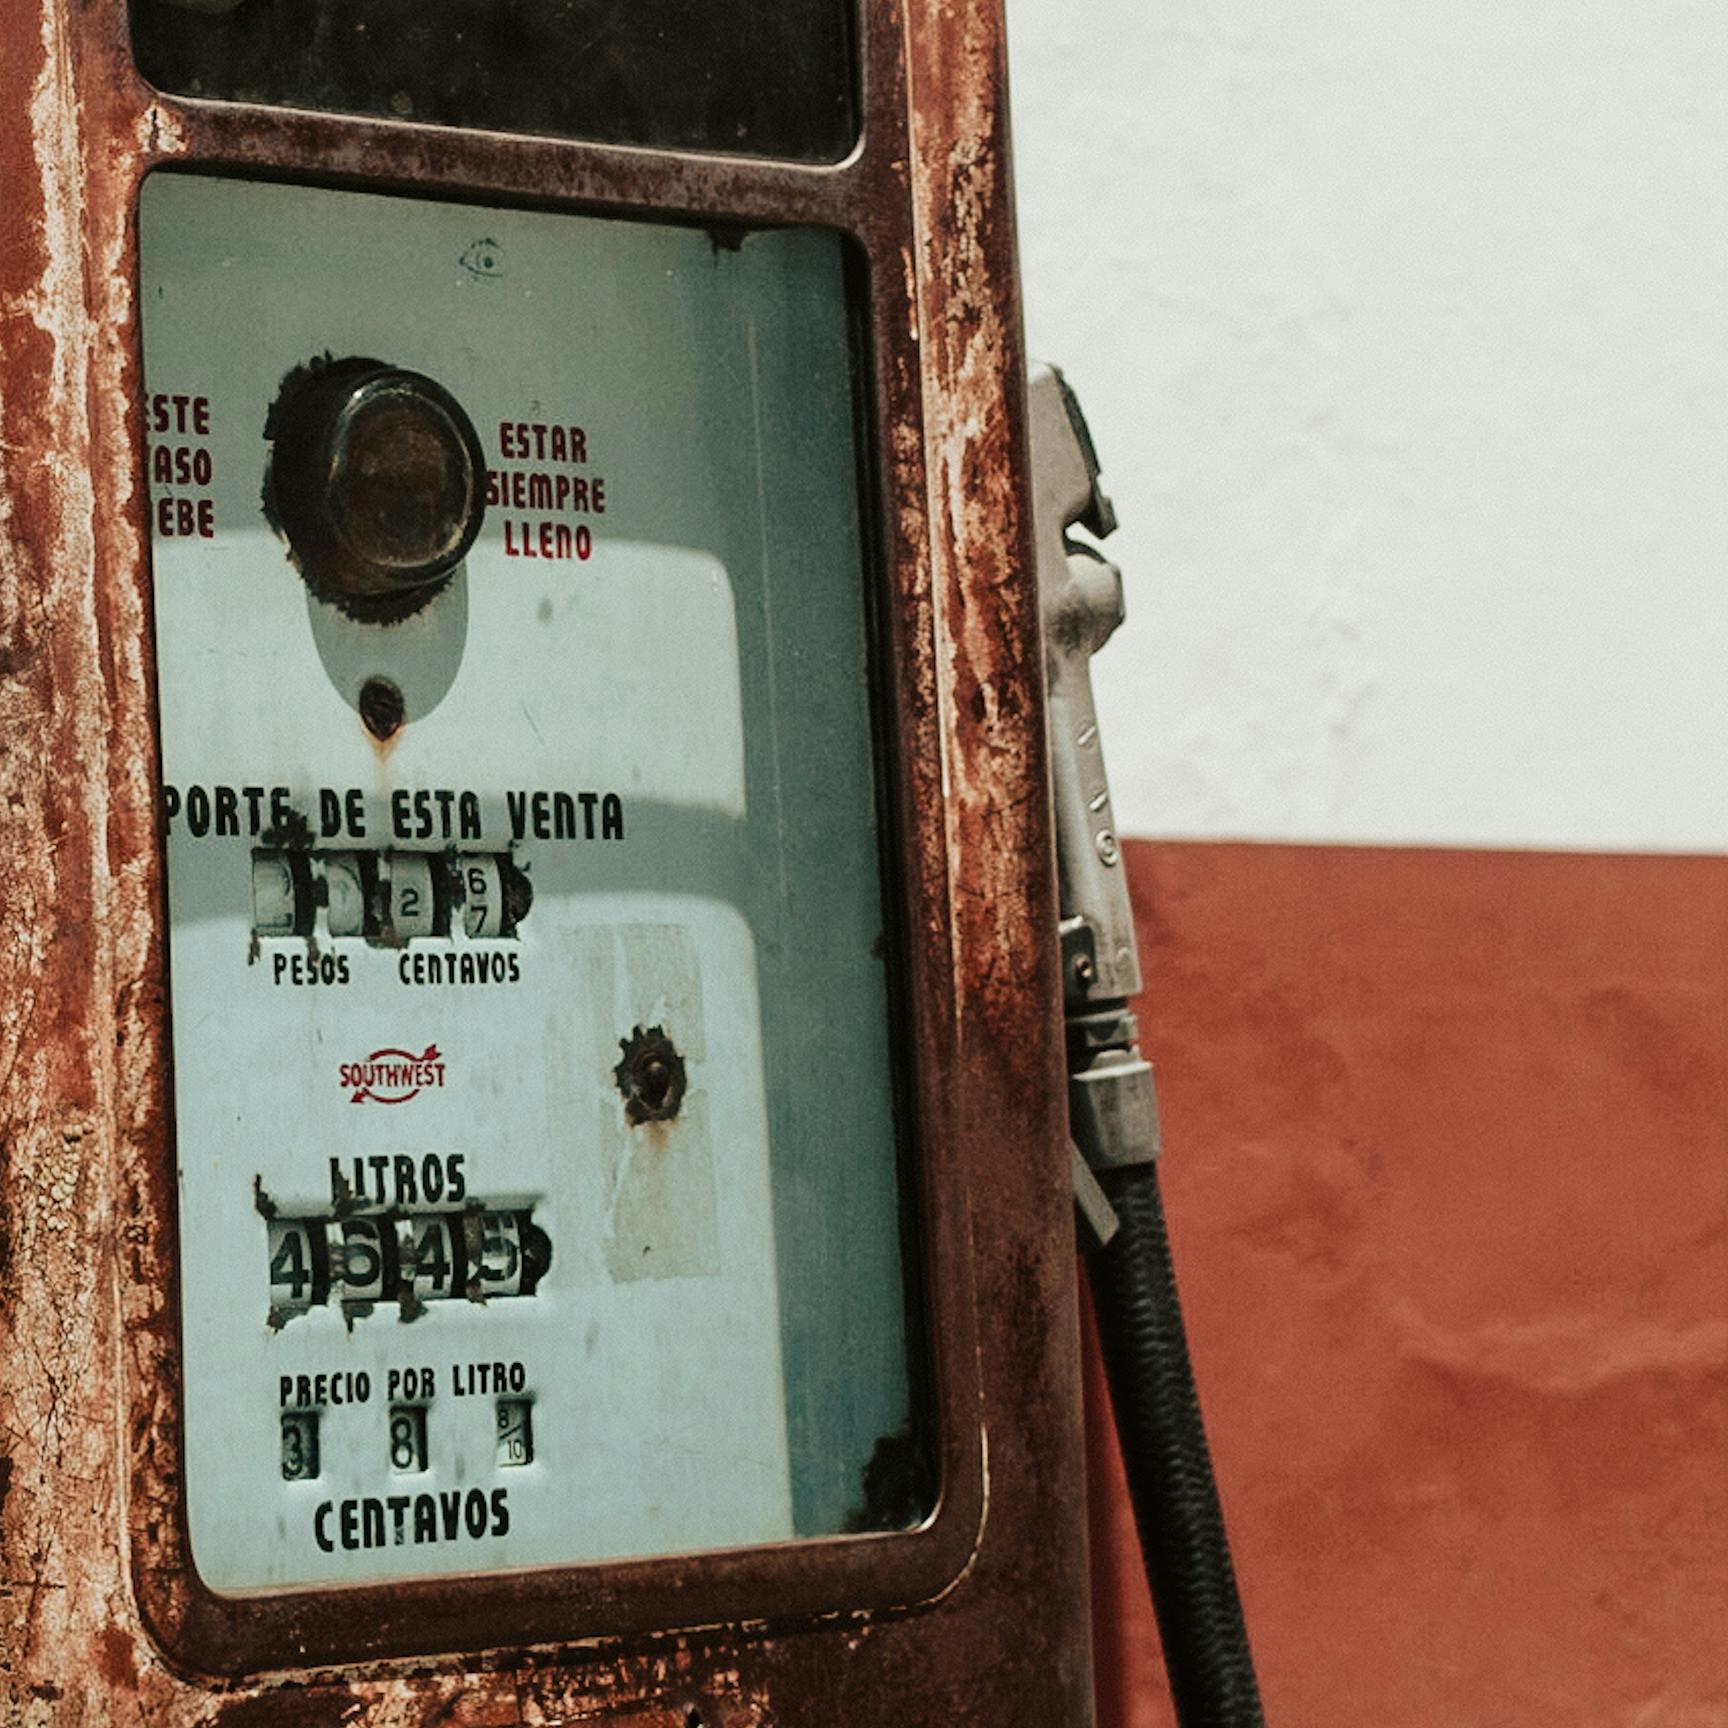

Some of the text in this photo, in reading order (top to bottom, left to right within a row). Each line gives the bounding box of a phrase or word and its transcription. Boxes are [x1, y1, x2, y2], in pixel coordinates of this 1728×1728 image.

[500, 422, 587, 463] ESTAR
[148, 445, 212, 486] ASO
[486, 470, 606, 513] SIEMPRE
[157, 497, 214, 538] EBE
[504, 520, 592, 560] LLENO
[160, 785, 624, 840] PORTE DE ESTA VENTA
[274, 952, 520, 986] PESOS CENTAVOS
[339, 1063, 445, 1087] SOUTHWEST
[329, 1153, 465, 1206] LITROS
[280, 1362, 525, 1407] PRECIO POR LITRO
[391, 1418, 413, 1468] 8
[314, 1488, 509, 1552] CENTAVOS
